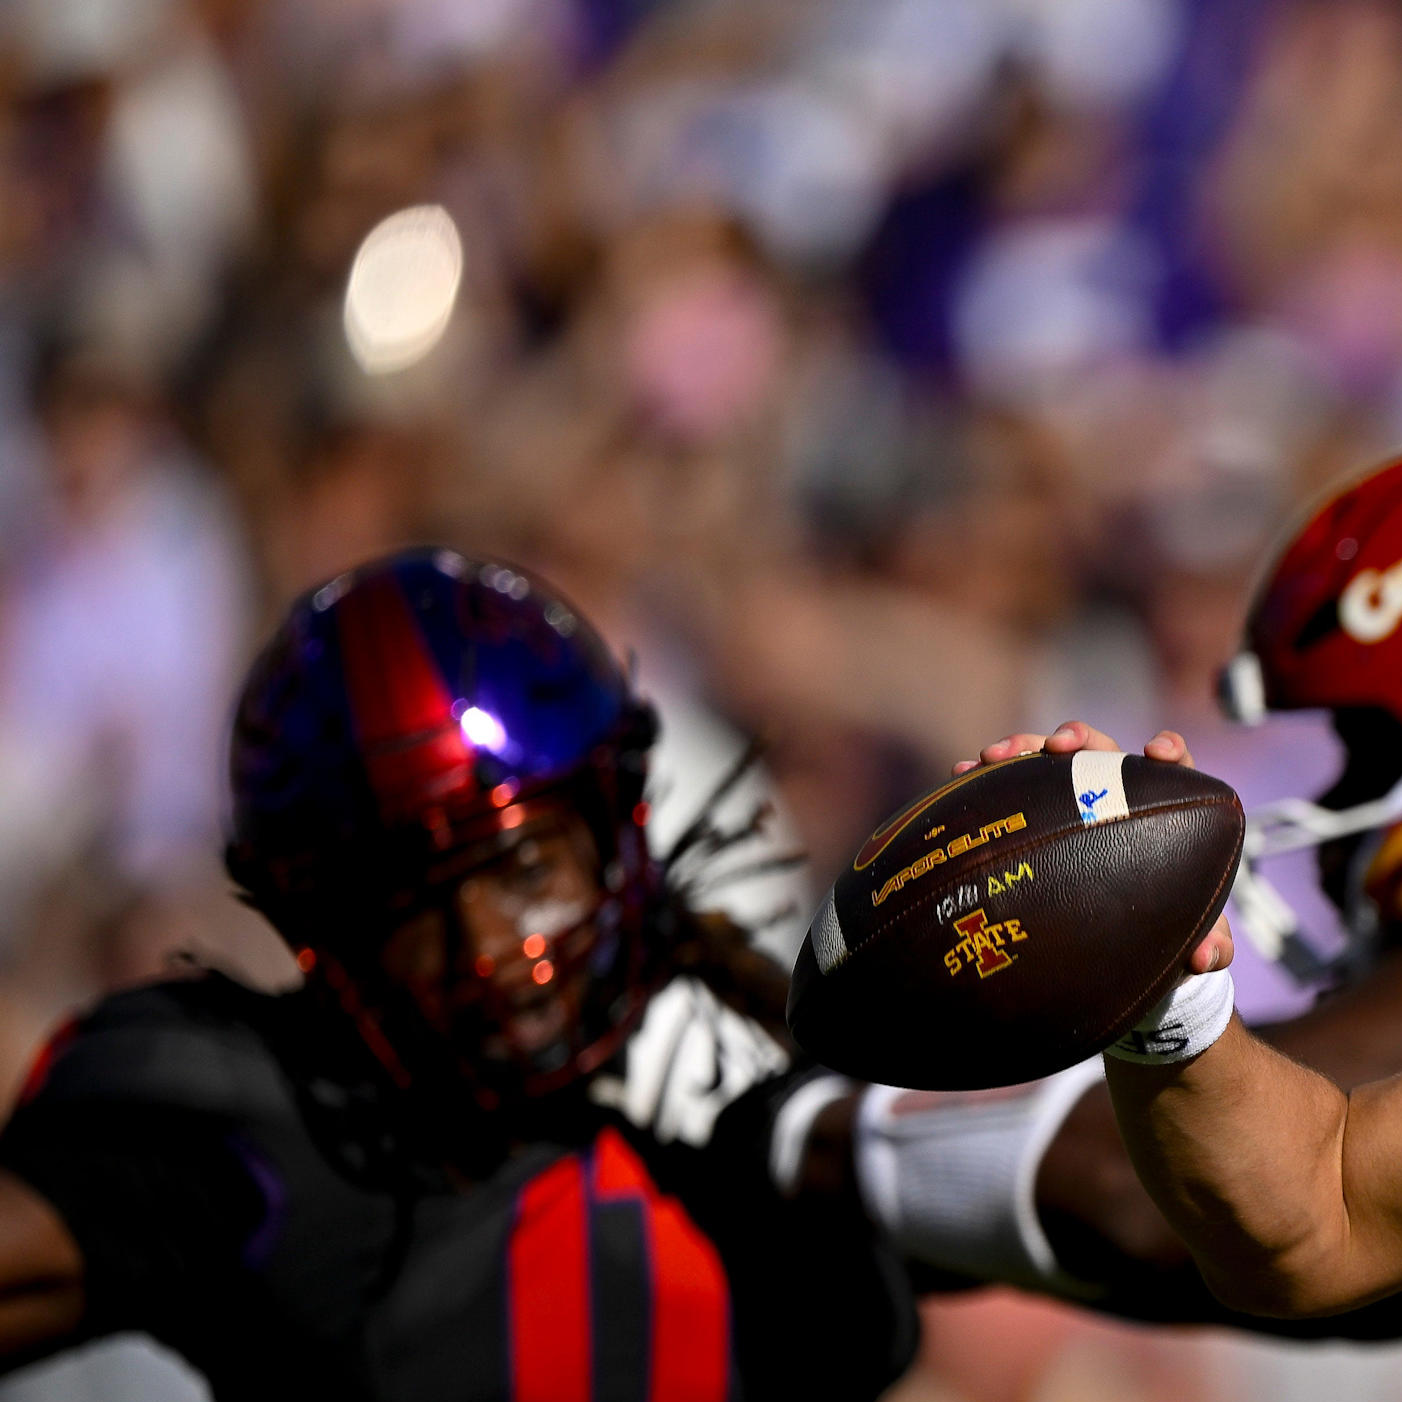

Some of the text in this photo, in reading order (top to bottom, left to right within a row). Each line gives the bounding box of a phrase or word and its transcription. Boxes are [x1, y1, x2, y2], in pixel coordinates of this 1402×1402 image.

[872, 812, 1028, 907] VAPOR ELITE
[987, 861, 1034, 898] AM
[943, 918, 1029, 977] STATE
